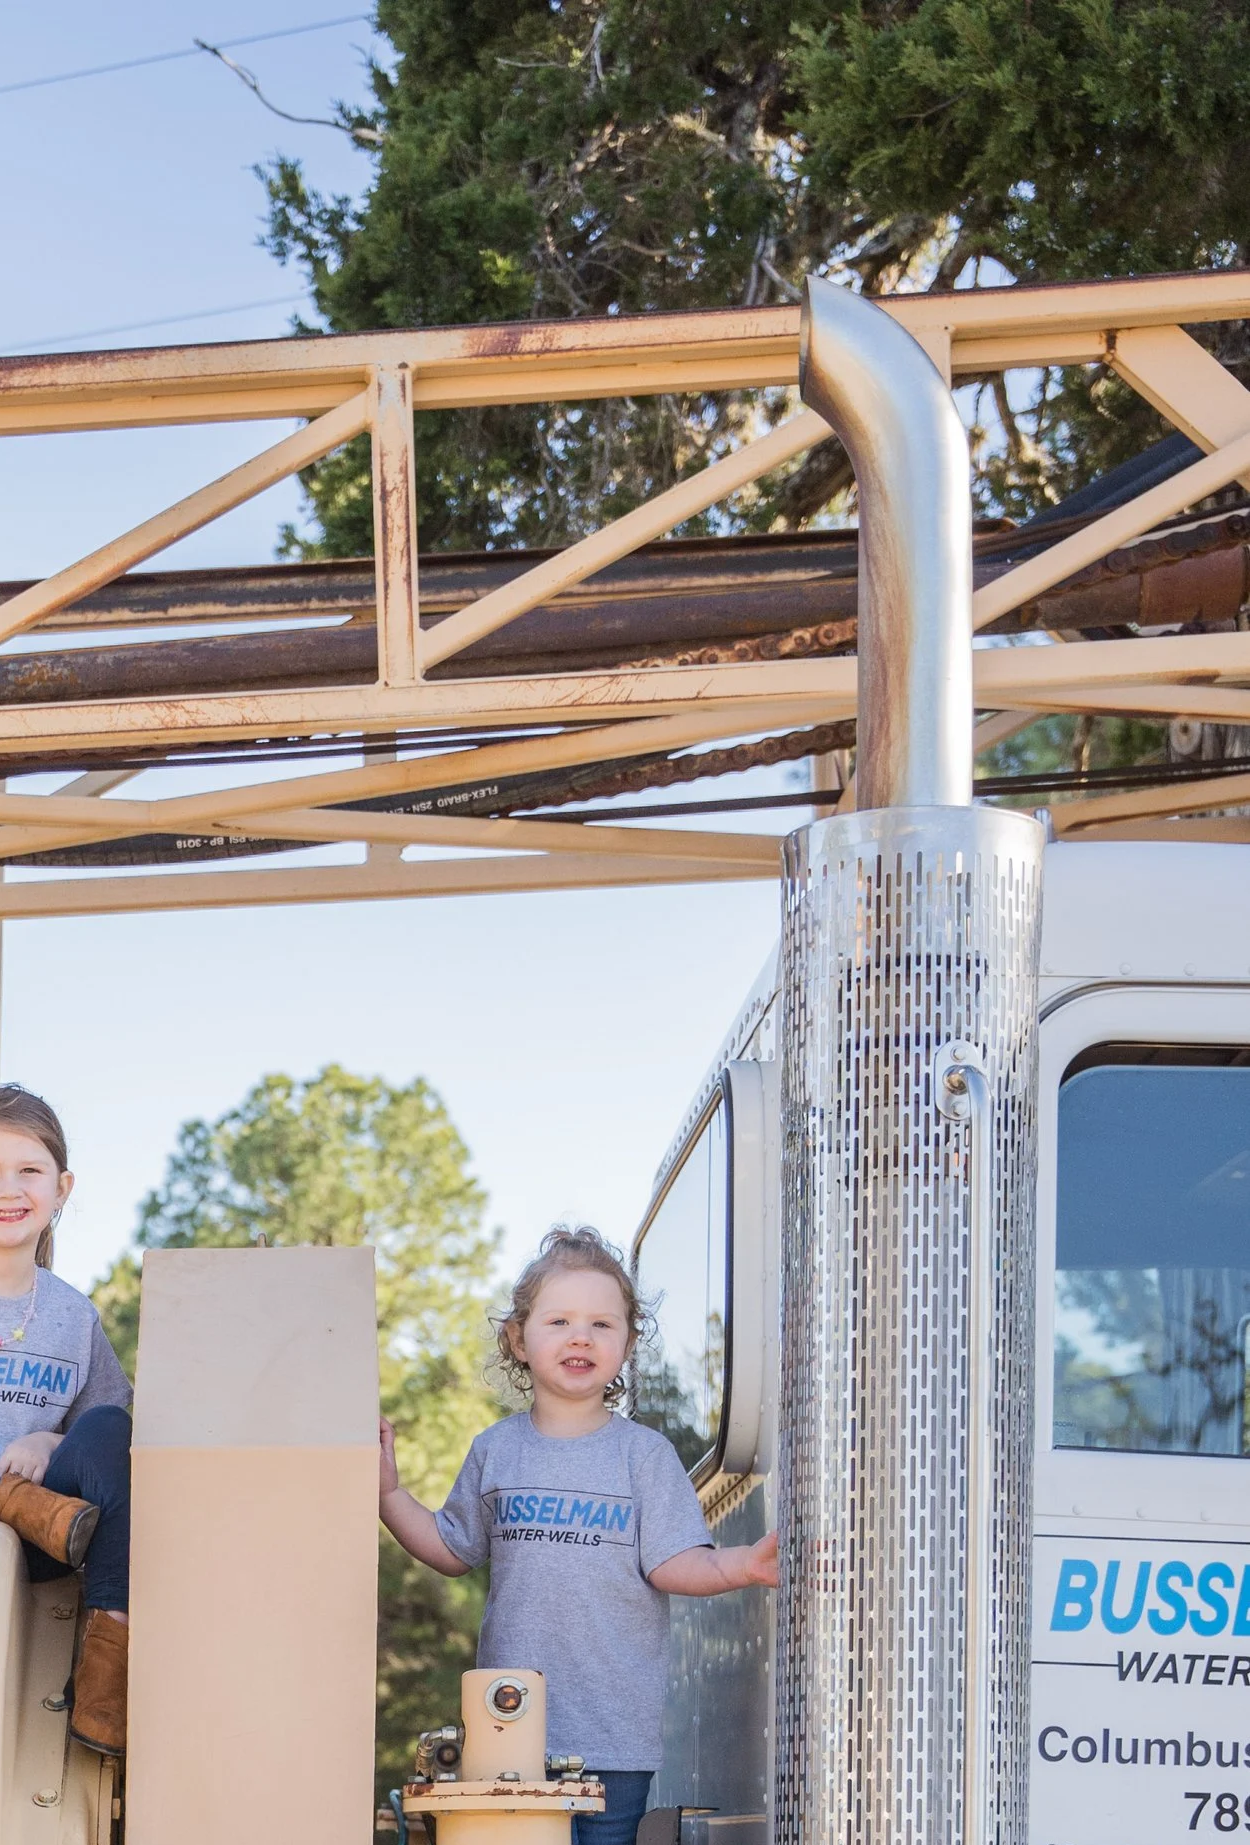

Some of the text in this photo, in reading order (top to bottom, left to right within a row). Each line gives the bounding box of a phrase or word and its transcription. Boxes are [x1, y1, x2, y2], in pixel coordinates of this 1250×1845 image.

[412, 800, 432, 813] 2SN
[436, 785, 498, 808] FLEX-BRAID
[209, 835, 224, 846] BP
[1, 1391, 48, 1408] WELLS
[502, 1529, 601, 1546] WATER WELLS
[1117, 1650, 1250, 1686] WATER
[1038, 1726, 1250, 1768] Columbu
[1184, 1792, 1250, 1832] 78
